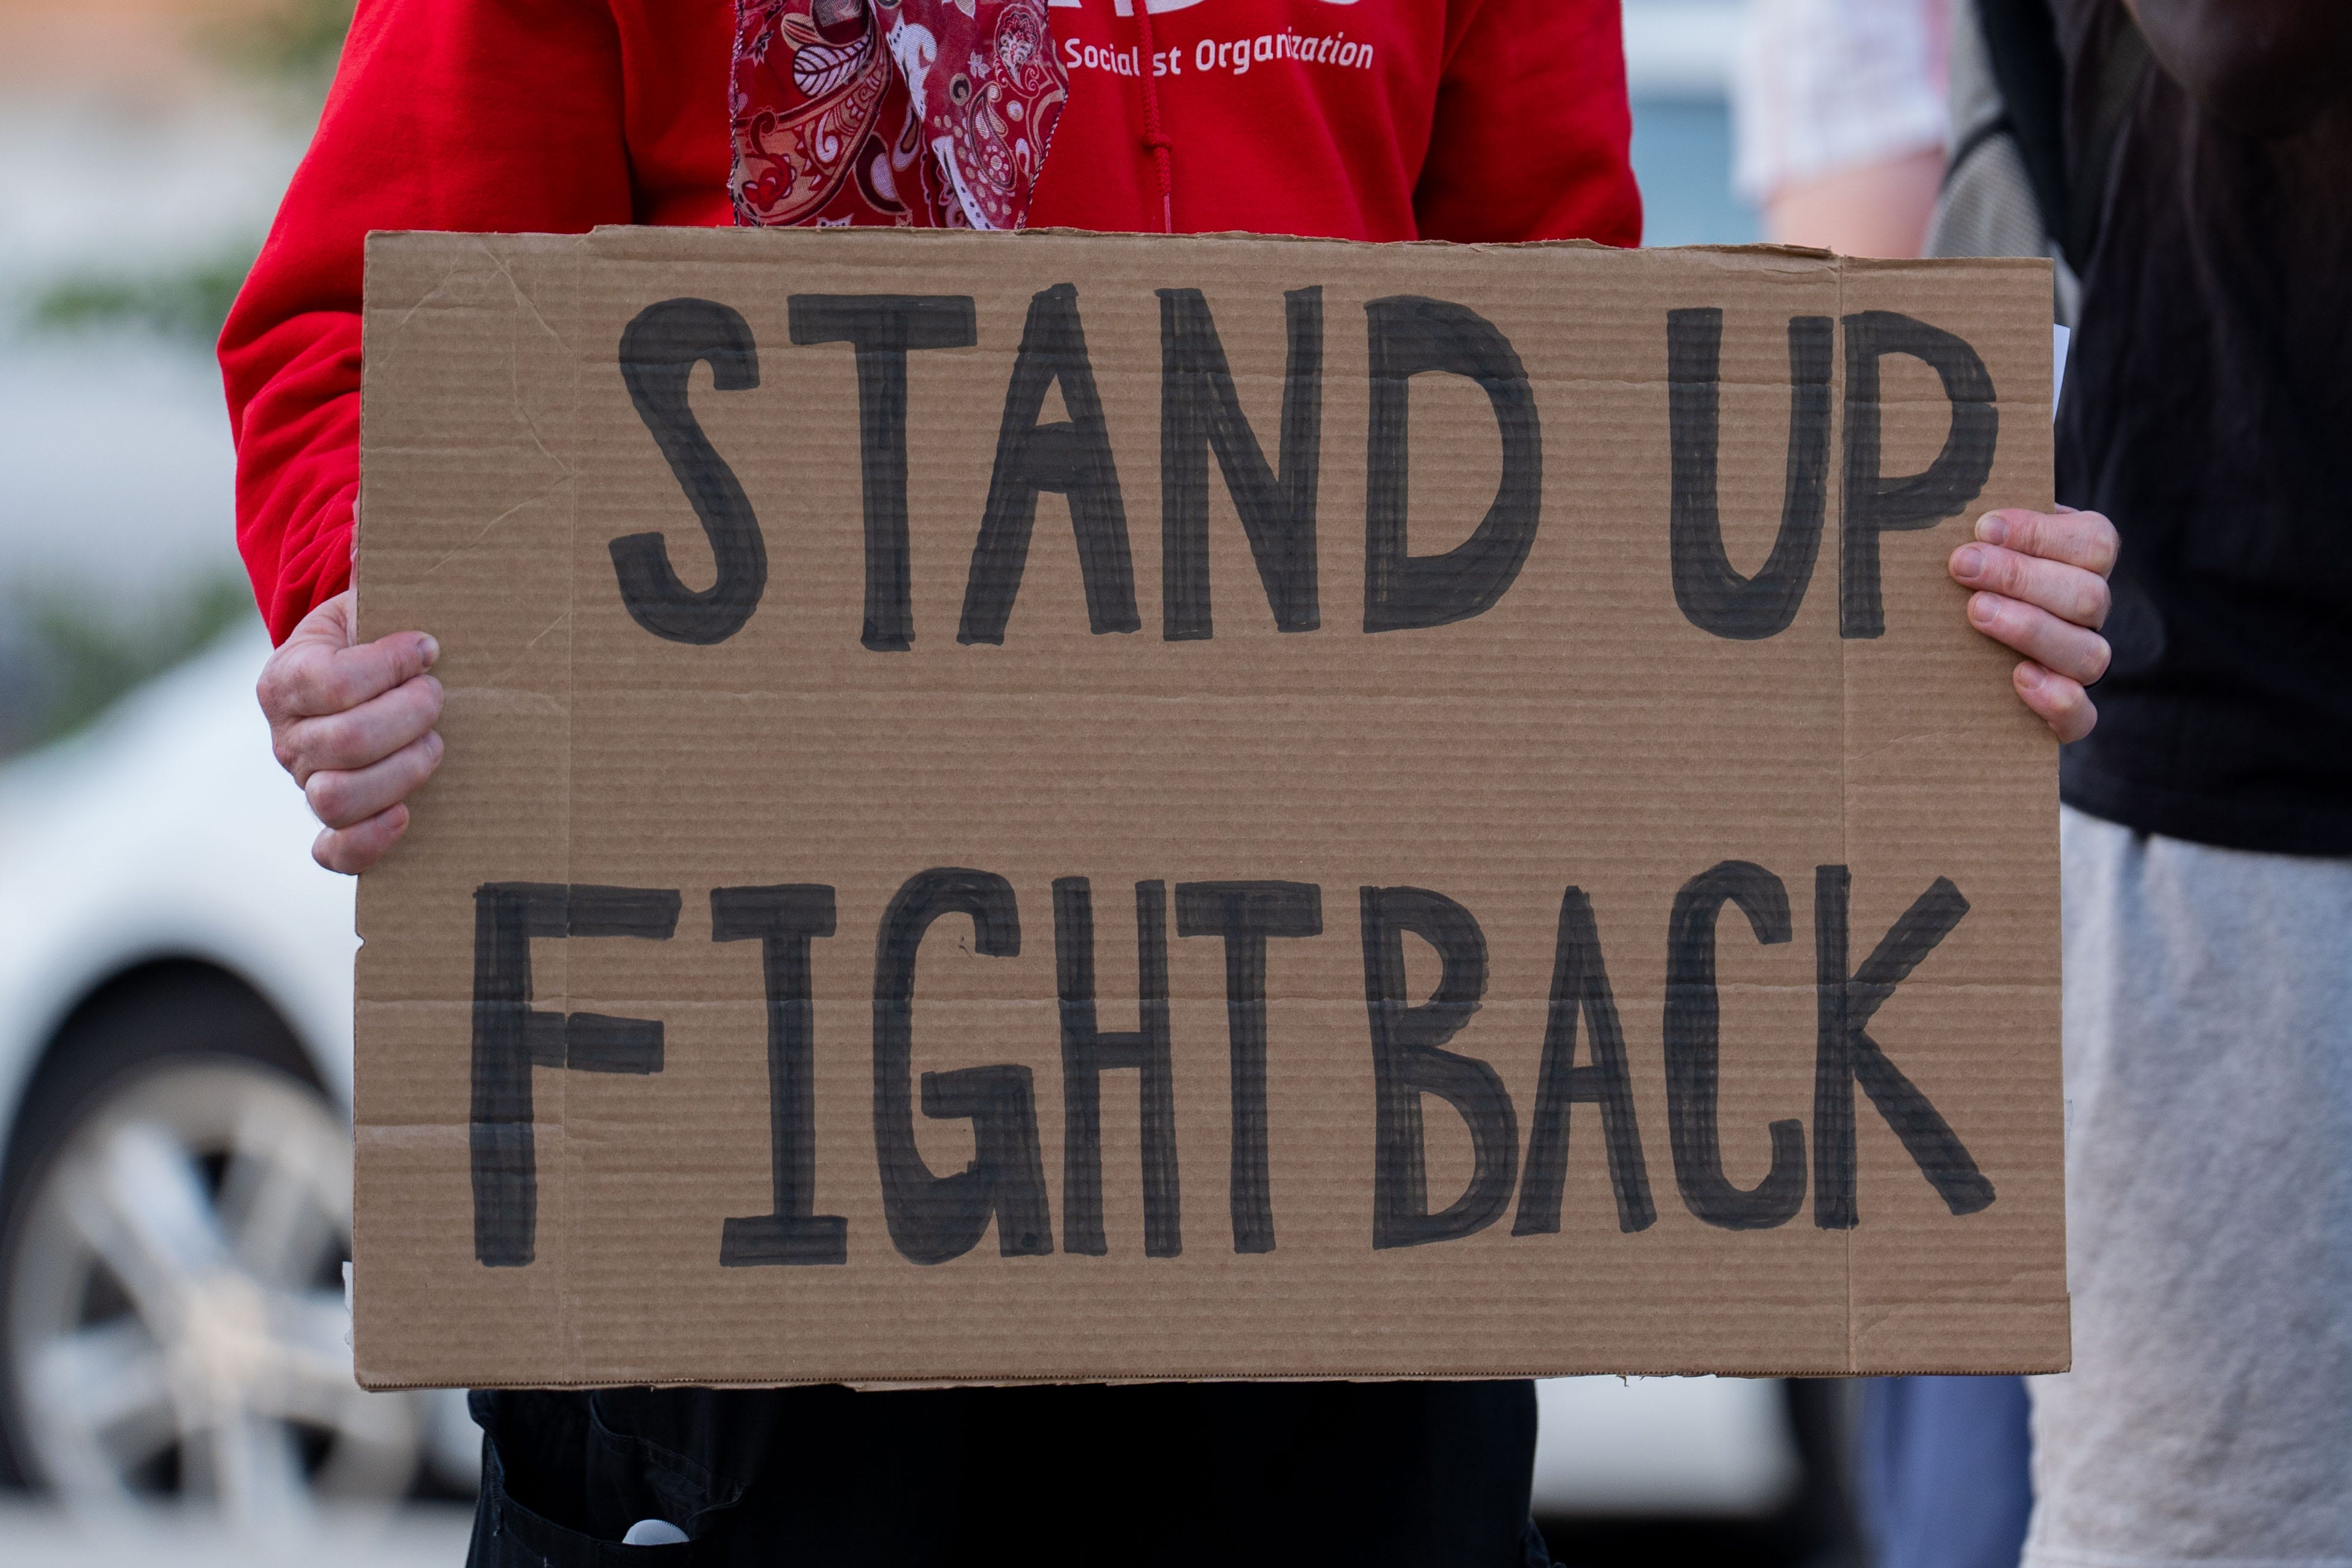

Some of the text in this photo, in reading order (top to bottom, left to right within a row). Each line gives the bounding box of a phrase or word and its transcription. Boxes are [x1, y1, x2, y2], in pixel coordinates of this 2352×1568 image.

[1064, 26, 1374, 77] Socialst Organization
[608, 282, 1999, 652] STAND UP
[468, 860, 1997, 1268] FIGHT BACK
